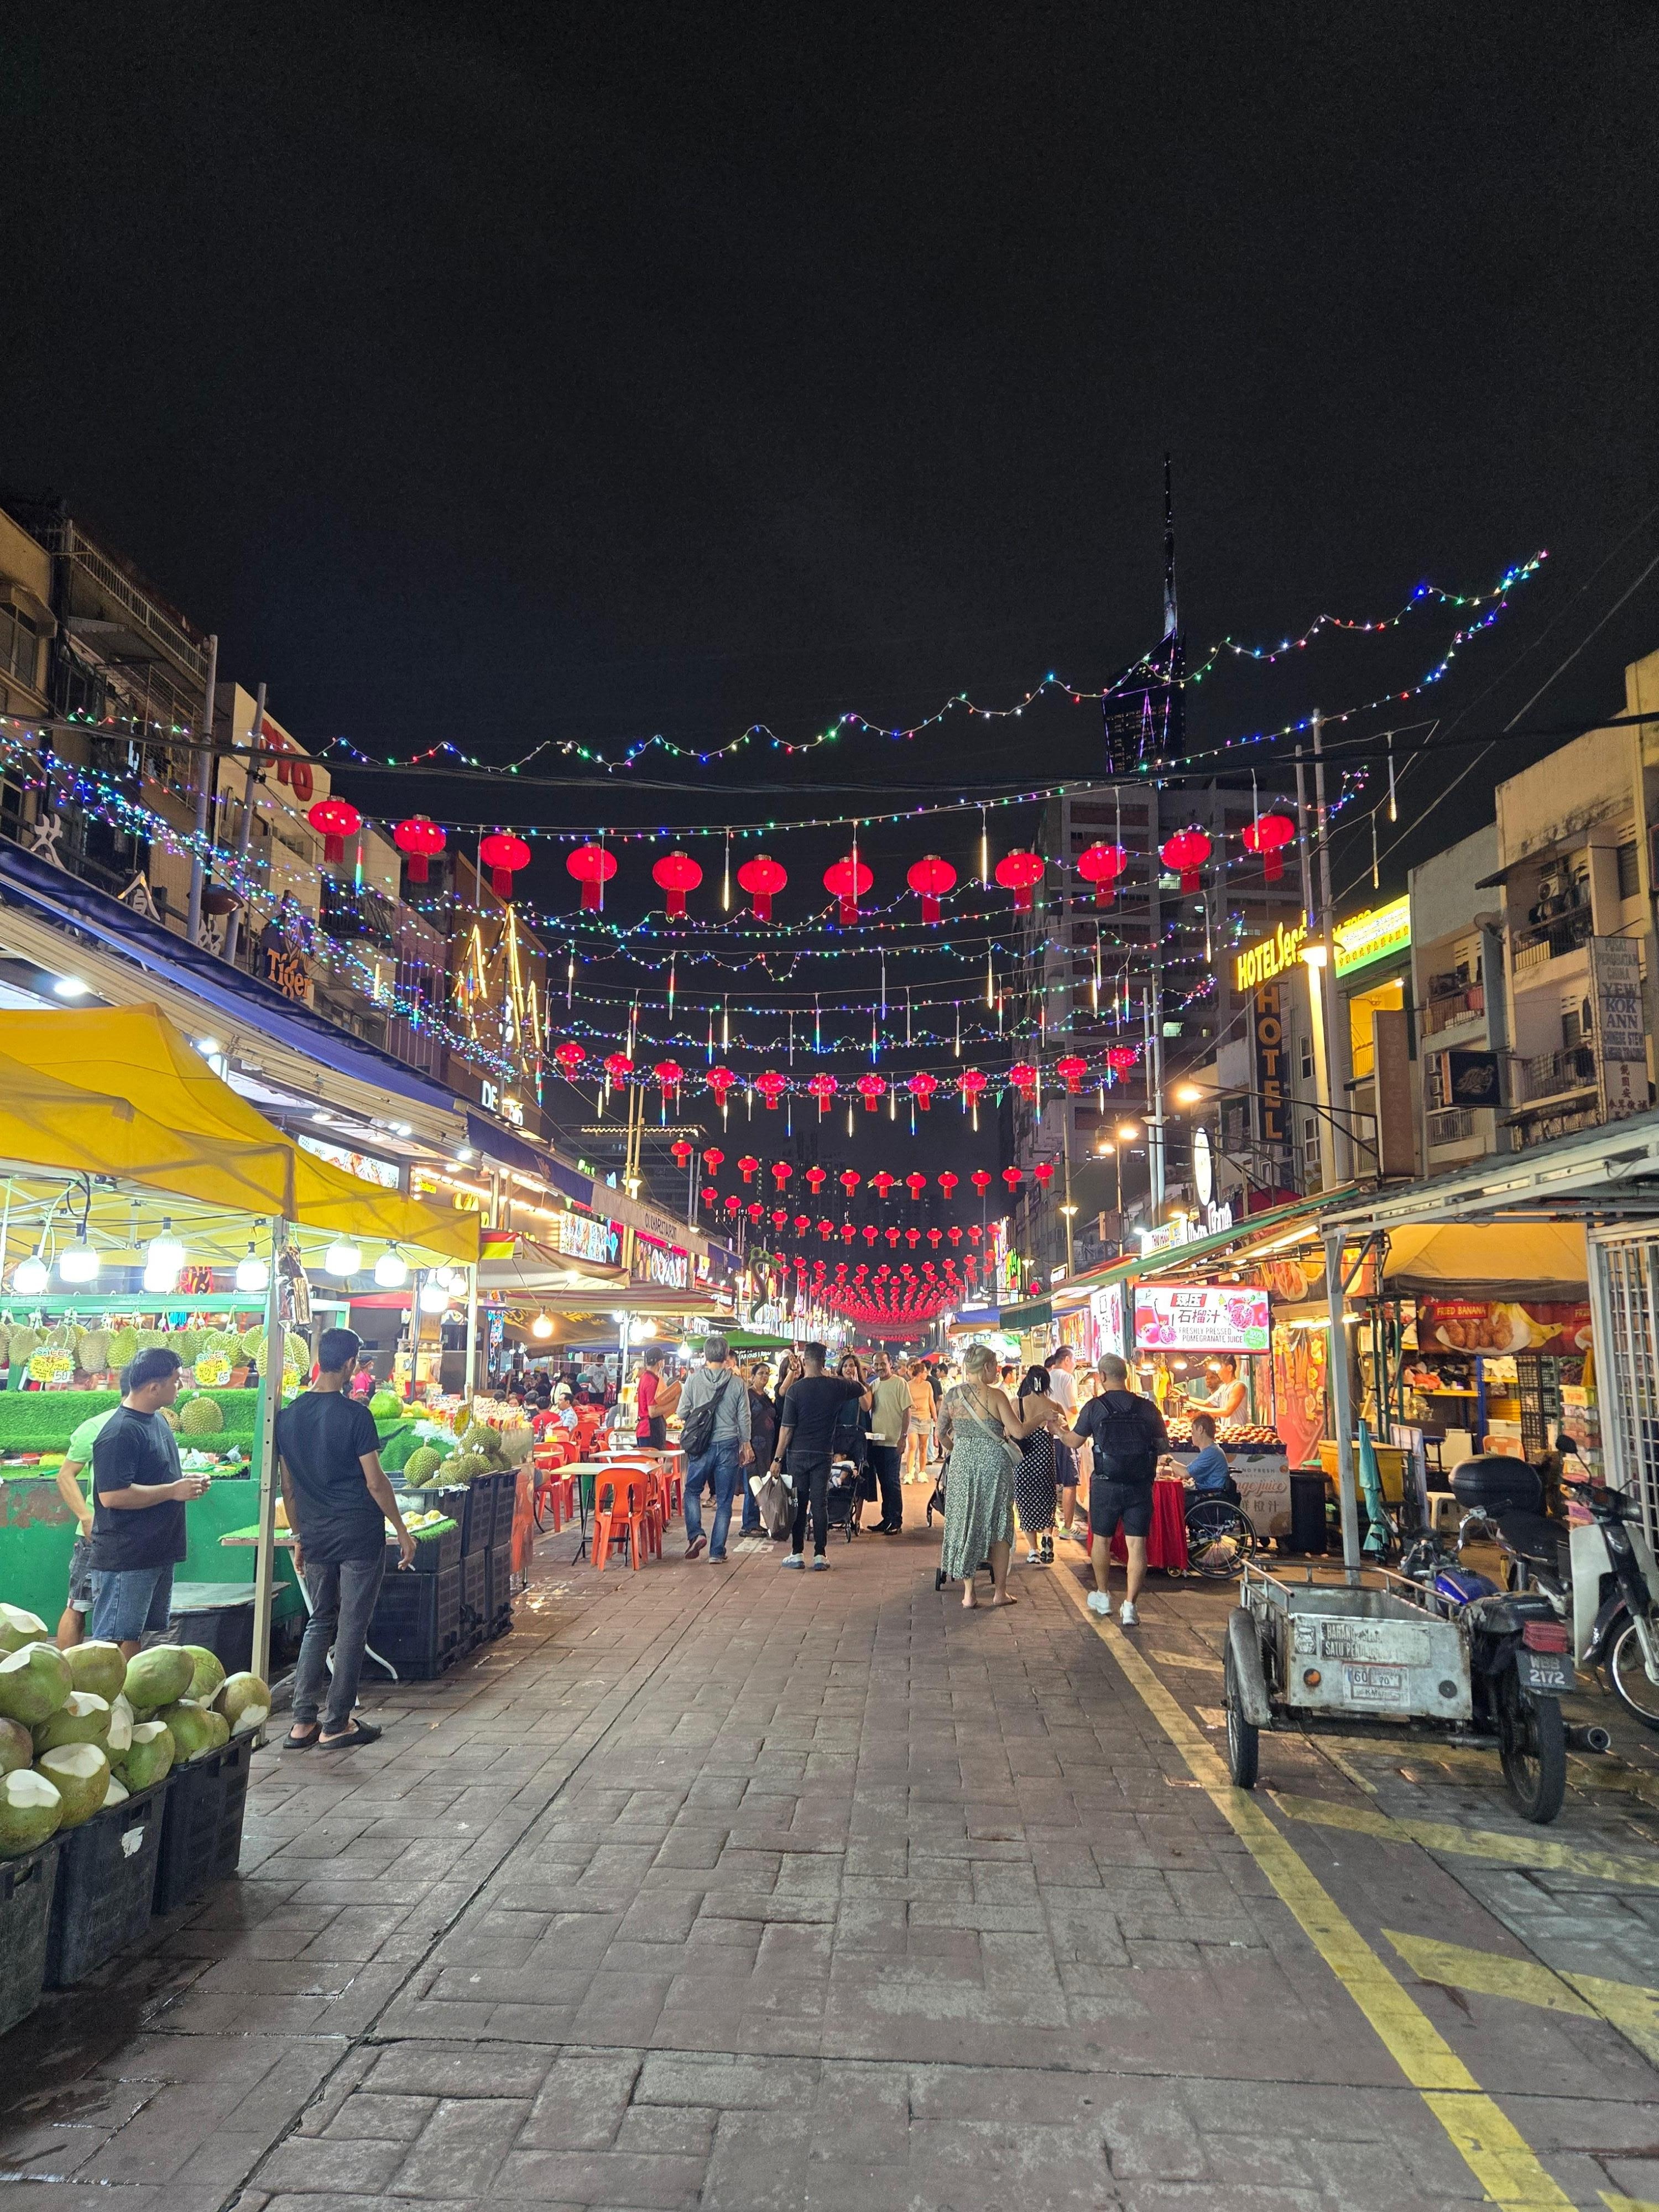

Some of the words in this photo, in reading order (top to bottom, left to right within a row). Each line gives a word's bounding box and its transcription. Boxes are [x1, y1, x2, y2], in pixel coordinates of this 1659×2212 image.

[1237, 938, 1279, 992] HOTEL
[267, 947, 314, 1000] Tiger
[1602, 982, 1637, 996] YEW
[1605, 998, 1637, 1013] KOK
[1606, 1014, 1639, 1029] ANN
[1258, 985, 1283, 1140] HOTEL
[1178, 1309, 1220, 1324] 石榴汁
[1437, 1307, 1456, 1316] FRIED
[1457, 1306, 1486, 1316] BANANA
[1179, 1327, 1204, 1335] FRESHLY
[1206, 1327, 1232, 1335] PRESSED
[1182, 1334, 1226, 1343] POMEGRANATE
[218, 1371, 228, 1382] 65
[1325, 1641, 1344, 1656] SATU
[1354, 1671, 1368, 1683] 60
[1530, 1669, 1566, 1685] 2172
